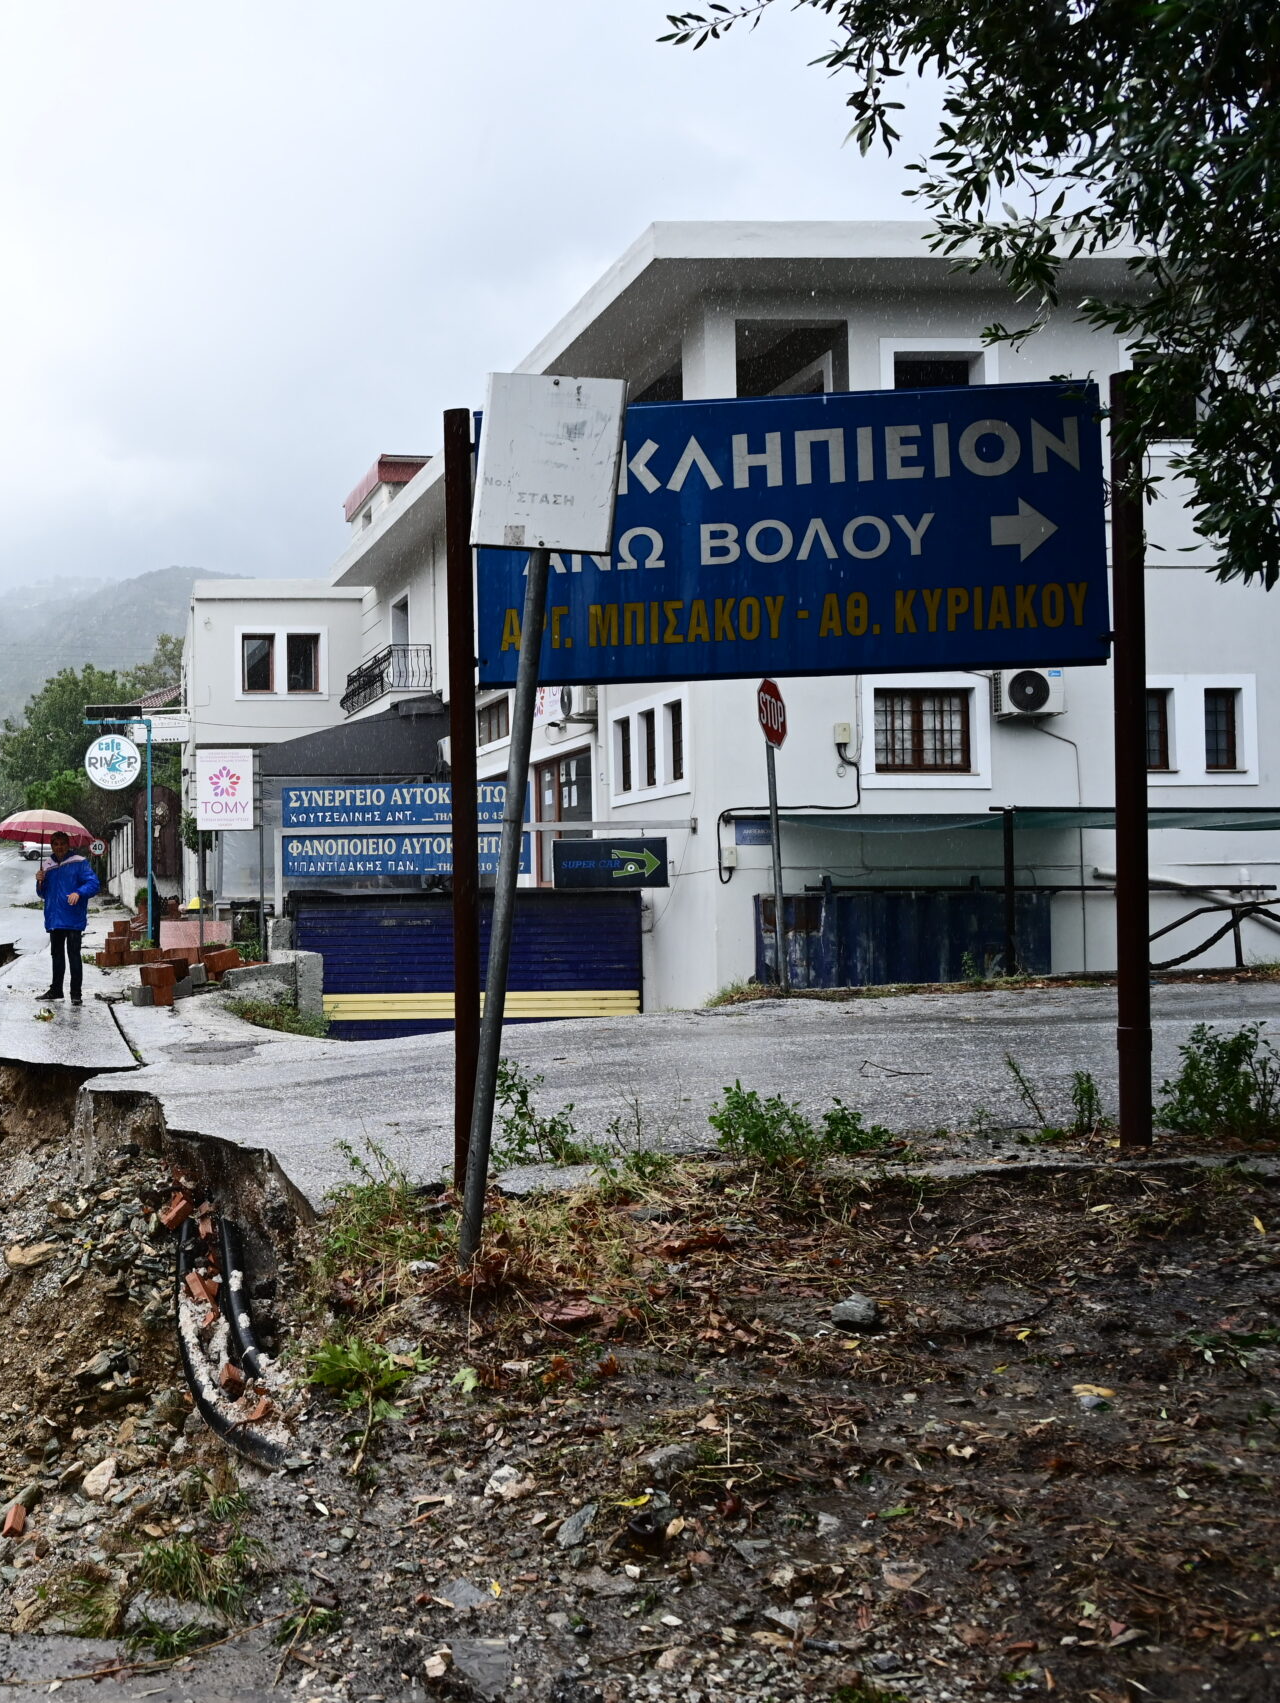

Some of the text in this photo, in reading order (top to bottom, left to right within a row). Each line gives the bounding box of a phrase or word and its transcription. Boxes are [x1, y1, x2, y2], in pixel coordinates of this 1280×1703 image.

[617, 416, 1081, 496] ΚΛΗΠΙΕΙΟΝ
[516, 491, 575, 507] ΣΤΑΣΗ
[699, 512, 936, 567] ΒΟΛΟΥ
[500, 605, 573, 651] ΑΓ.
[588, 595, 786, 648] ΜΠΙΣΑΚΟΥ
[818, 591, 882, 638] ΑΘ.
[894, 581, 1089, 635] ΚΥΡΙΑΚΟΥ
[759, 691, 786, 733] STOP
[98, 739, 121, 752] cafe
[288, 785, 508, 808] ΣΥΝΕΡΓΕΙΟ ΑΥΤΟΚΗΤΩ
[201, 801, 249, 815] TOMY
[290, 811, 381, 823] ΚΟΥΤΣΕΛΙΝΗΣ
[385, 810, 417, 822] ΑΝΤ.
[92, 843, 104, 852] 40
[288, 837, 397, 857] ΦΑΝΟΠΟΙΕΙΟ
[288, 861, 383, 873] ΜΠΑΝΤΙΔΑΚΗΣ
[387, 860, 419, 872] ΠΑΝ.
[561, 859, 621, 869] SUPER CAR
